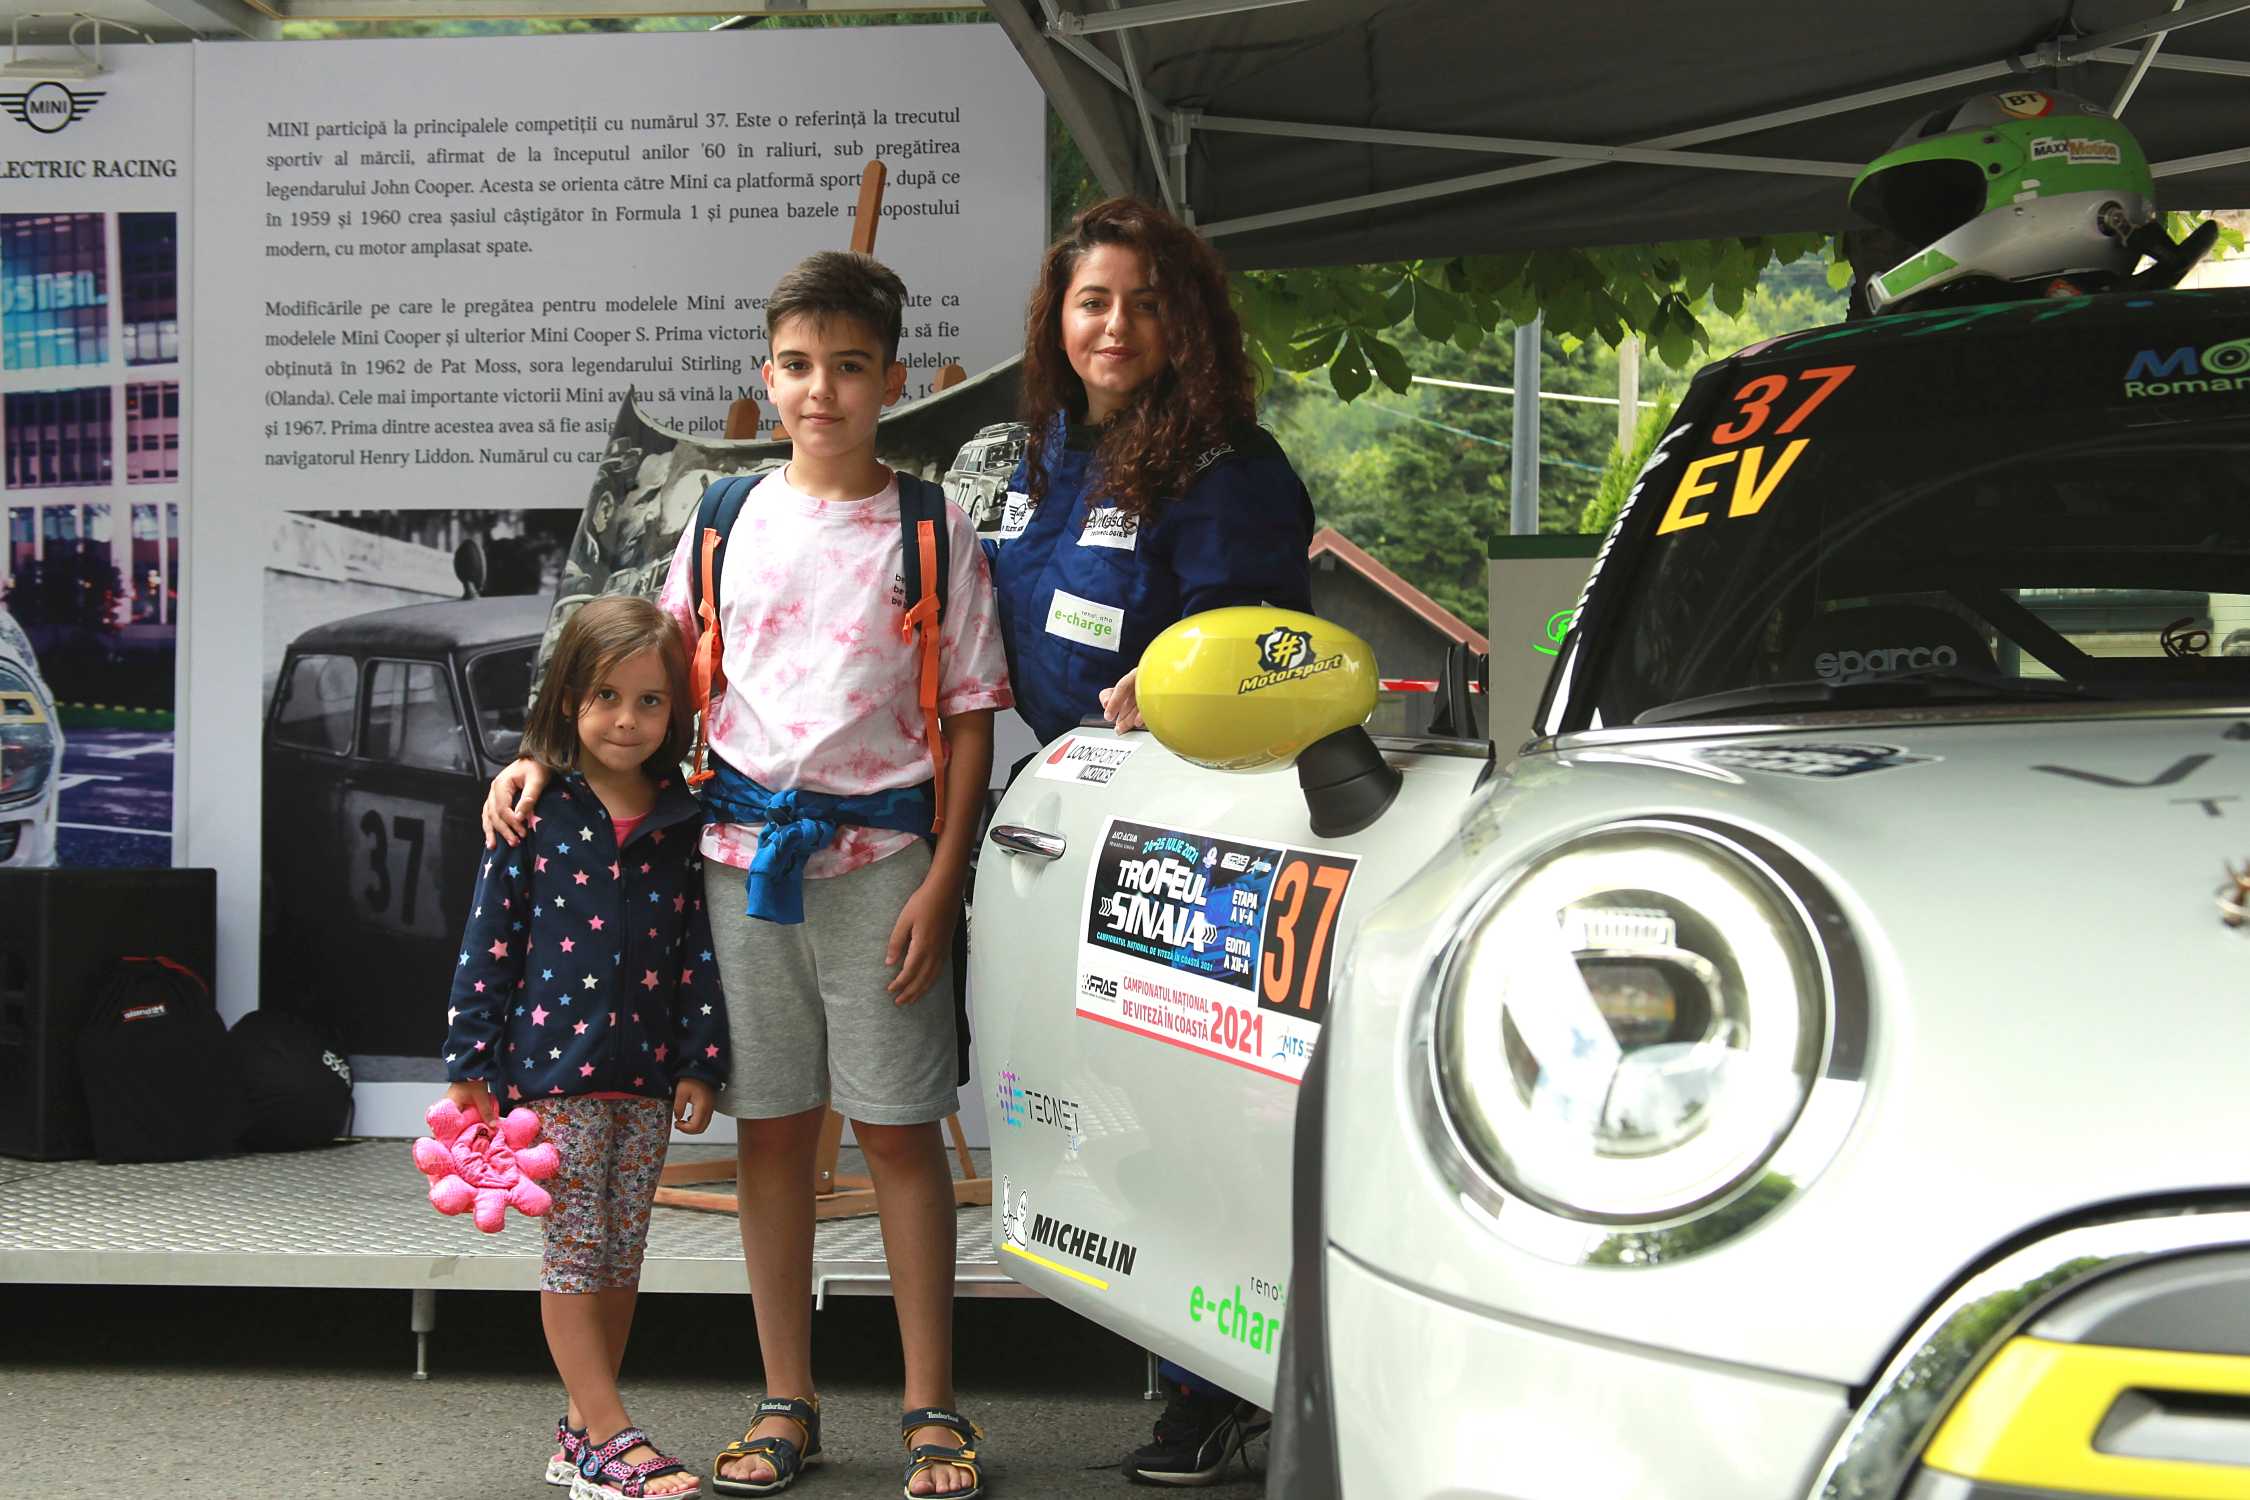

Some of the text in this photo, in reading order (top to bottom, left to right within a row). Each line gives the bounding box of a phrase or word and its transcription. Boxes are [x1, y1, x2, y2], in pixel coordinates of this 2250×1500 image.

[30, 100, 68, 114] MINI
[266, 122, 310, 137] MINI
[315, 121, 388, 141] participă
[393, 119, 408, 135] la
[413, 117, 510, 138] principalele
[603, 120, 625, 131] cu
[630, 113, 699, 130] numărul
[705, 113, 729, 128] 37.
[735, 112, 772, 128] Este
[777, 116, 789, 127] o
[872, 109, 889, 125] la
[894, 107, 961, 126] trecutul
[93, 159, 177, 178] RACING
[266, 152, 323, 171] sportiv
[334, 150, 349, 166] al
[360, 149, 416, 165] mărcii,
[426, 148, 485, 164] afirmat
[496, 147, 517, 163] de
[527, 146, 542, 162] la
[553, 144, 630, 166] începutul
[641, 144, 690, 160] anilor
[736, 143, 755, 158] în
[766, 141, 822, 159] raliuri,
[833, 140, 864, 156] sub
[875, 139, 961, 161] pregătirea
[266, 169, 961, 201] legendarului John Cooper. Acesta se orienta către Mini ca platformă după ce
[265, 213, 283, 227] în
[290, 211, 332, 227] 1959
[337, 211, 353, 229] și
[361, 209, 402, 225] 1960
[407, 213, 443, 224] crea
[449, 208, 497, 227] șasiul
[590, 207, 609, 222] în
[615, 204, 682, 222] Formula
[690, 204, 699, 219] 1
[706, 204, 722, 222] și
[728, 207, 780, 223] punea
[785, 201, 840, 218] bazele
[265, 238, 534, 258] modern, cu motor amplasat spate.
[264, 295, 961, 319] Modificările pe care le pregătea pentru modelele Mini ca
[264, 330, 337, 346] modelele
[341, 330, 380, 345] Mini
[383, 329, 442, 348] Cooper
[445, 329, 460, 347] și
[464, 328, 527, 343] ulterior
[529, 328, 569, 343] Mini
[573, 327, 632, 346] Cooper
[635, 326, 651, 342] S.
[654, 326, 704, 341] Prima
[914, 321, 933, 338] să
[937, 321, 960, 337] fie
[265, 360, 333, 379] obținută
[341, 361, 357, 375] în
[367, 359, 406, 375] 1962
[413, 358, 433, 374] de
[441, 358, 466, 374] Pat
[474, 358, 521, 375] Moss,
[529, 360, 564, 373] sora
[571, 356, 673, 377] legendarului
[681, 354, 742, 375] Stirling
[264, 390, 336, 406] (Olanda).
[337, 389, 374, 405] Cele
[376, 389, 407, 404] mai
[410, 389, 500, 408] importante
[502, 388, 562, 403] victorii
[565, 387, 605, 403] Mini
[657, 387, 676, 402] să
[679, 386, 715, 401] vină
[719, 385, 733, 401] la
[1711, 364, 1857, 446] 37
[264, 421, 279, 439] și
[285, 420, 327, 436] 1967.
[331, 420, 378, 435] Prima
[381, 419, 431, 434] dintre
[434, 421, 494, 434] acestea
[498, 422, 534, 433] avea
[538, 418, 556, 433] să
[559, 417, 581, 432] fie
[264, 447, 574, 469] navigatorul Henry Liddon. Numărul cu
[1656, 438, 1811, 536] EV
[1055, 610, 1112, 637] e-charge
[1238, 654, 1344, 695] Motorsport
[1815, 645, 1958, 685] sparco
[360, 809, 425, 927] 37
[1117, 857, 1208, 907] TROFEUL
[1231, 889, 1259, 910] ETAPA
[1107, 891, 1205, 953] SINAIA
[1263, 860, 1350, 1010] 37
[1088, 974, 1119, 998] FRAS
[1123, 976, 1172, 1003] CAMPIONATUL
[1122, 999, 1209, 1041] DE VITEZĂ ÎN COASTĂ
[1210, 1001, 1264, 1057] 2021
[1283, 1035, 1305, 1057] MTS
[1024, 1089, 1080, 1134] TECNET
[1031, 1213, 1138, 1276] MICHELIN
[1249, 1275, 1282, 1302] reno
[1189, 1284, 1281, 1355] e-char
